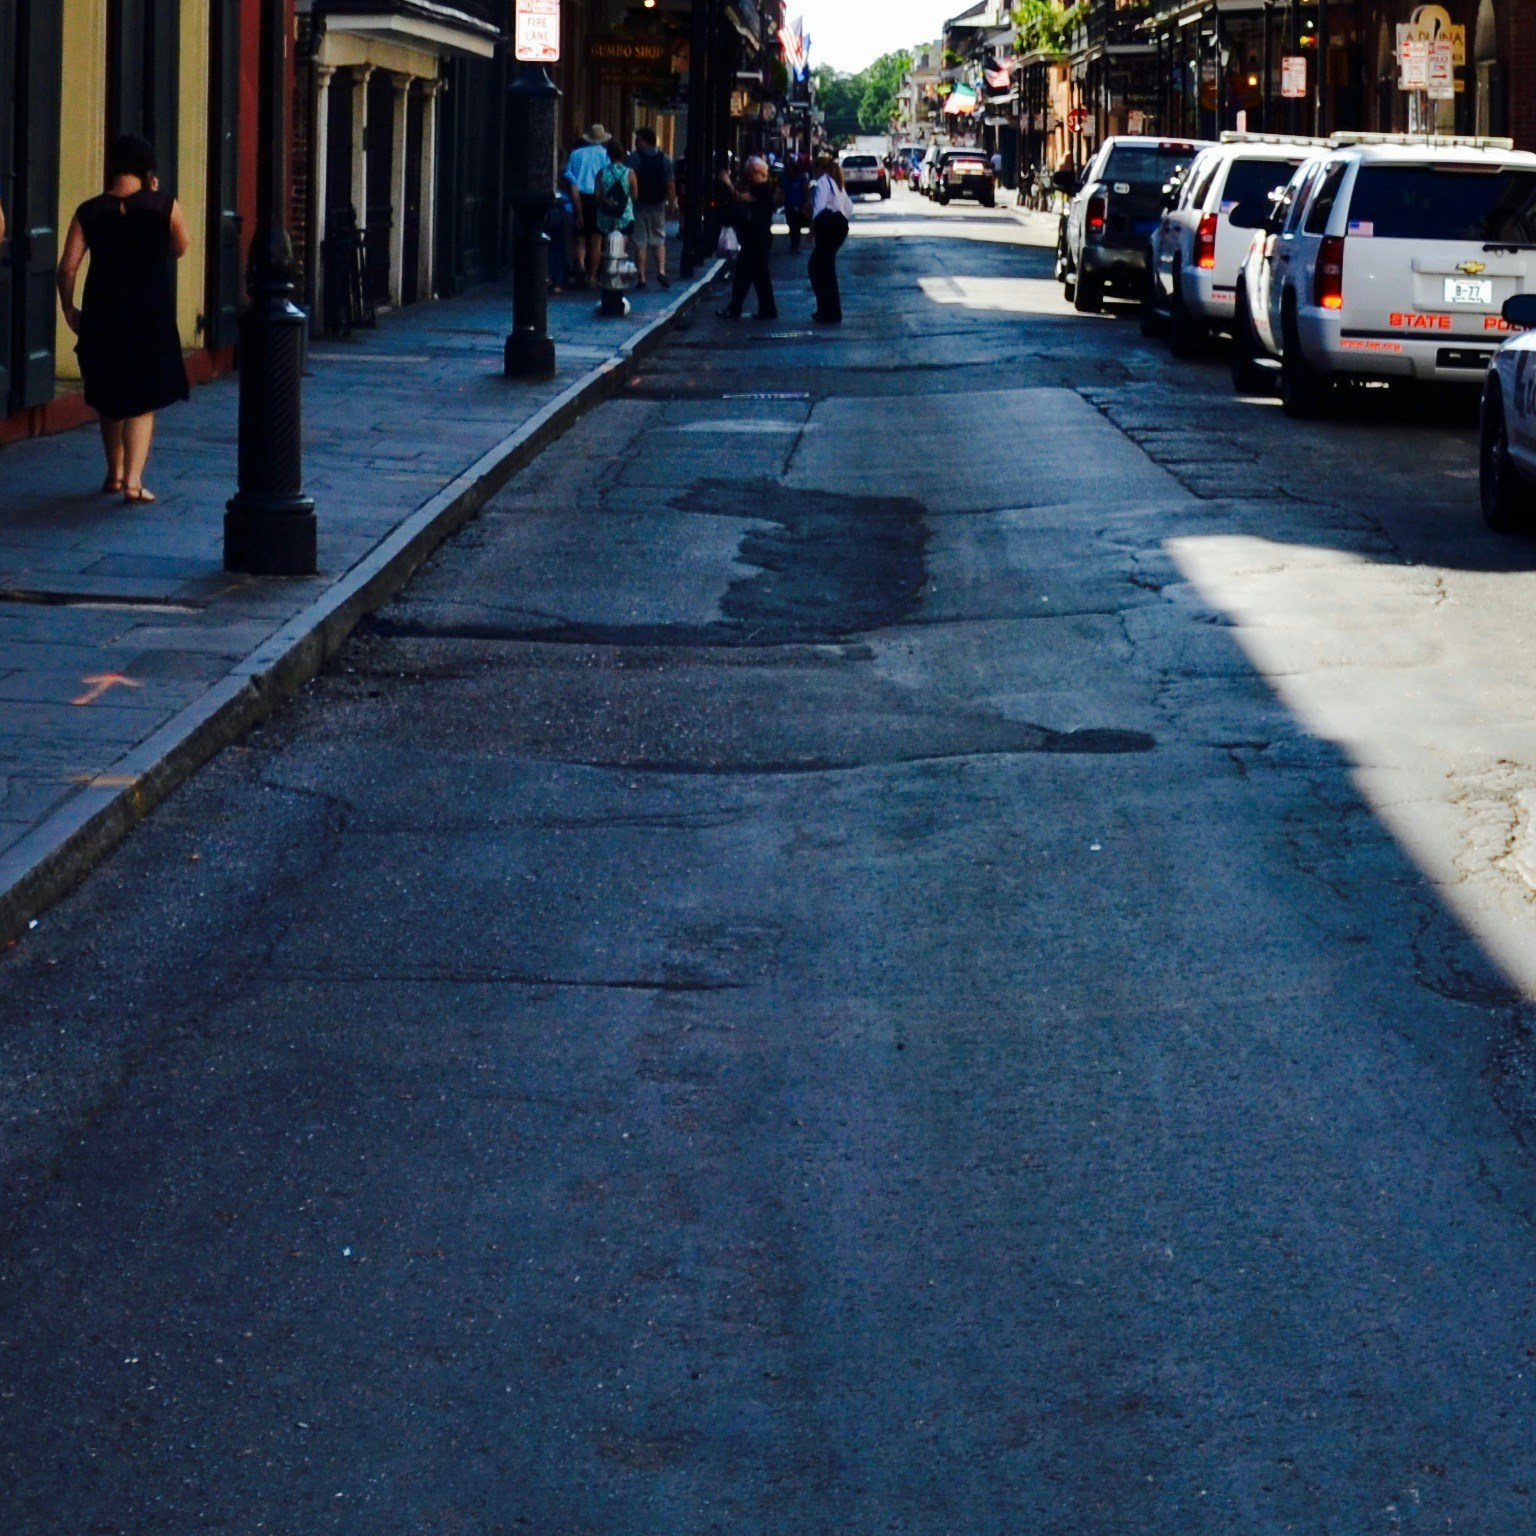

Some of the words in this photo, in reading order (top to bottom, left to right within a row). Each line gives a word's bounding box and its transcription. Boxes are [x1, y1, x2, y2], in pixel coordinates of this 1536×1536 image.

[527, 17, 548, 28] FIRE
[525, 30, 549, 42] LANE
[590, 43, 632, 58] GUMBO
[634, 44, 665, 60] SHOP
[1455, 285, 1480, 298] B-77
[1389, 312, 1452, 330] STATE
